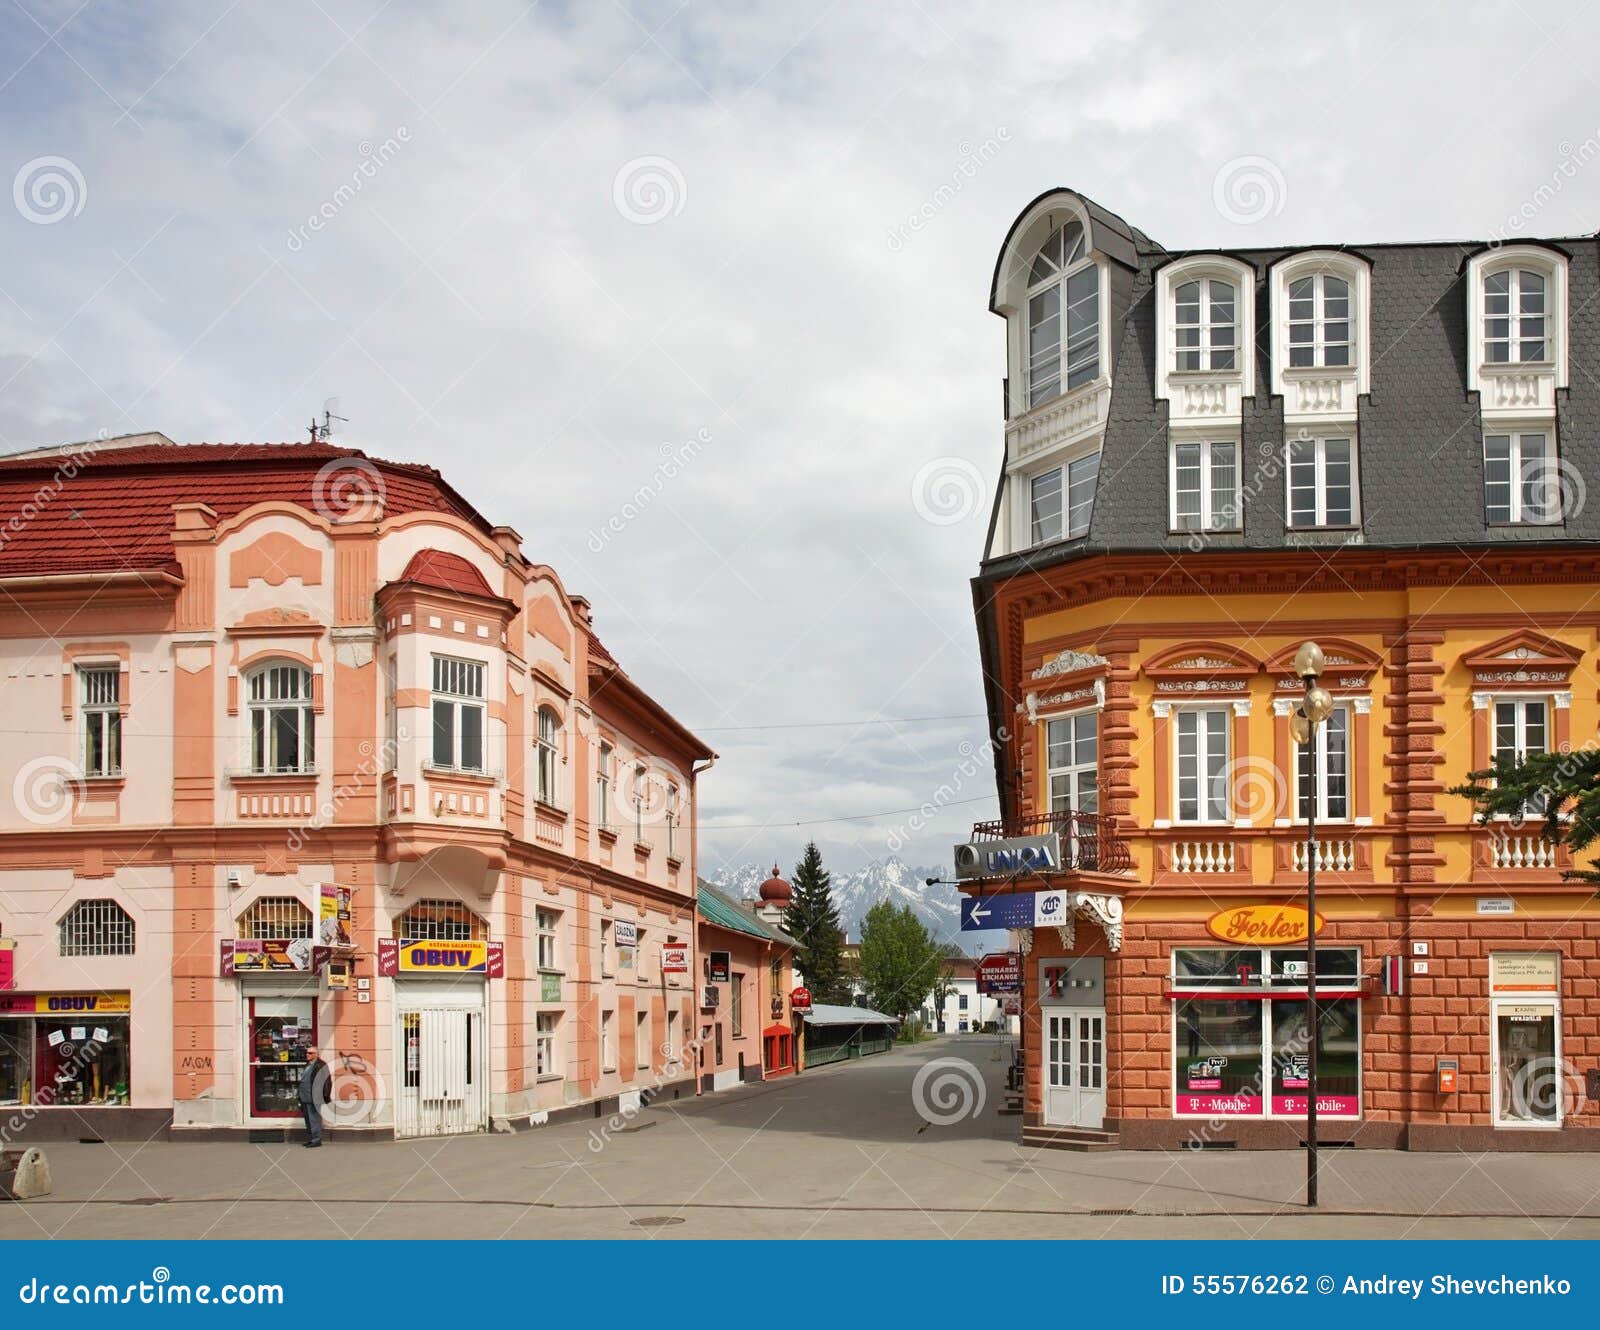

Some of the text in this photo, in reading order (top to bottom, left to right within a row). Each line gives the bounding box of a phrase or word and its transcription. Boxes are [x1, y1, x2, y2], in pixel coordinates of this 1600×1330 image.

[986, 845, 1056, 872] UNIQA
[1226, 910, 1305, 938] Fertex
[411, 948, 473, 967] OBUV
[48, 996, 97, 1010] OBUV
